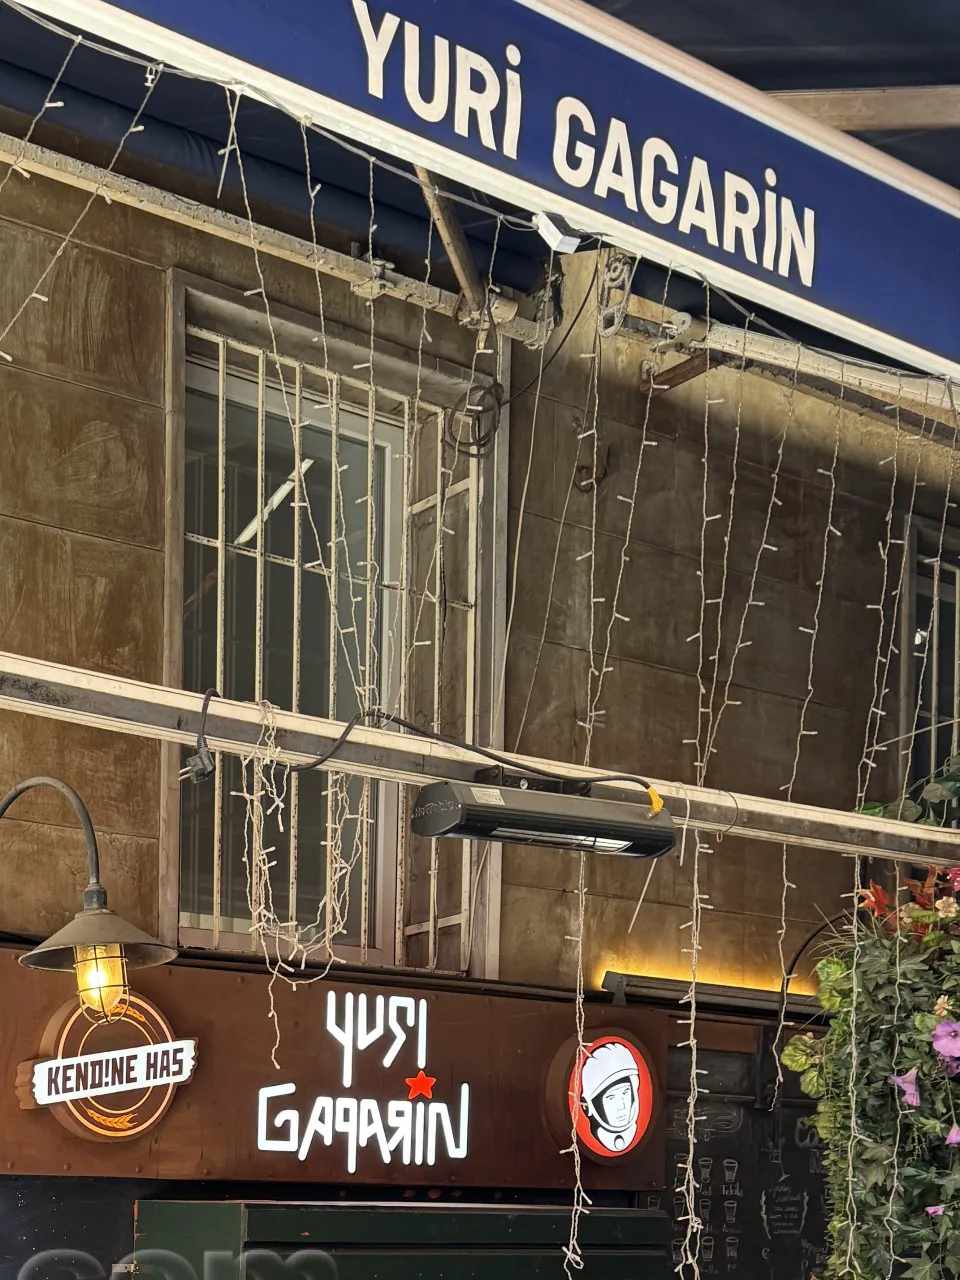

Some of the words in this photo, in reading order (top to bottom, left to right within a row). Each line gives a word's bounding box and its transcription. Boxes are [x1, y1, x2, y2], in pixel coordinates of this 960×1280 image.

[552, 95, 817, 288] GAGARİN
[145, 1047, 185, 1081] HAS
[257, 1082, 470, 1174] GAGARIN
